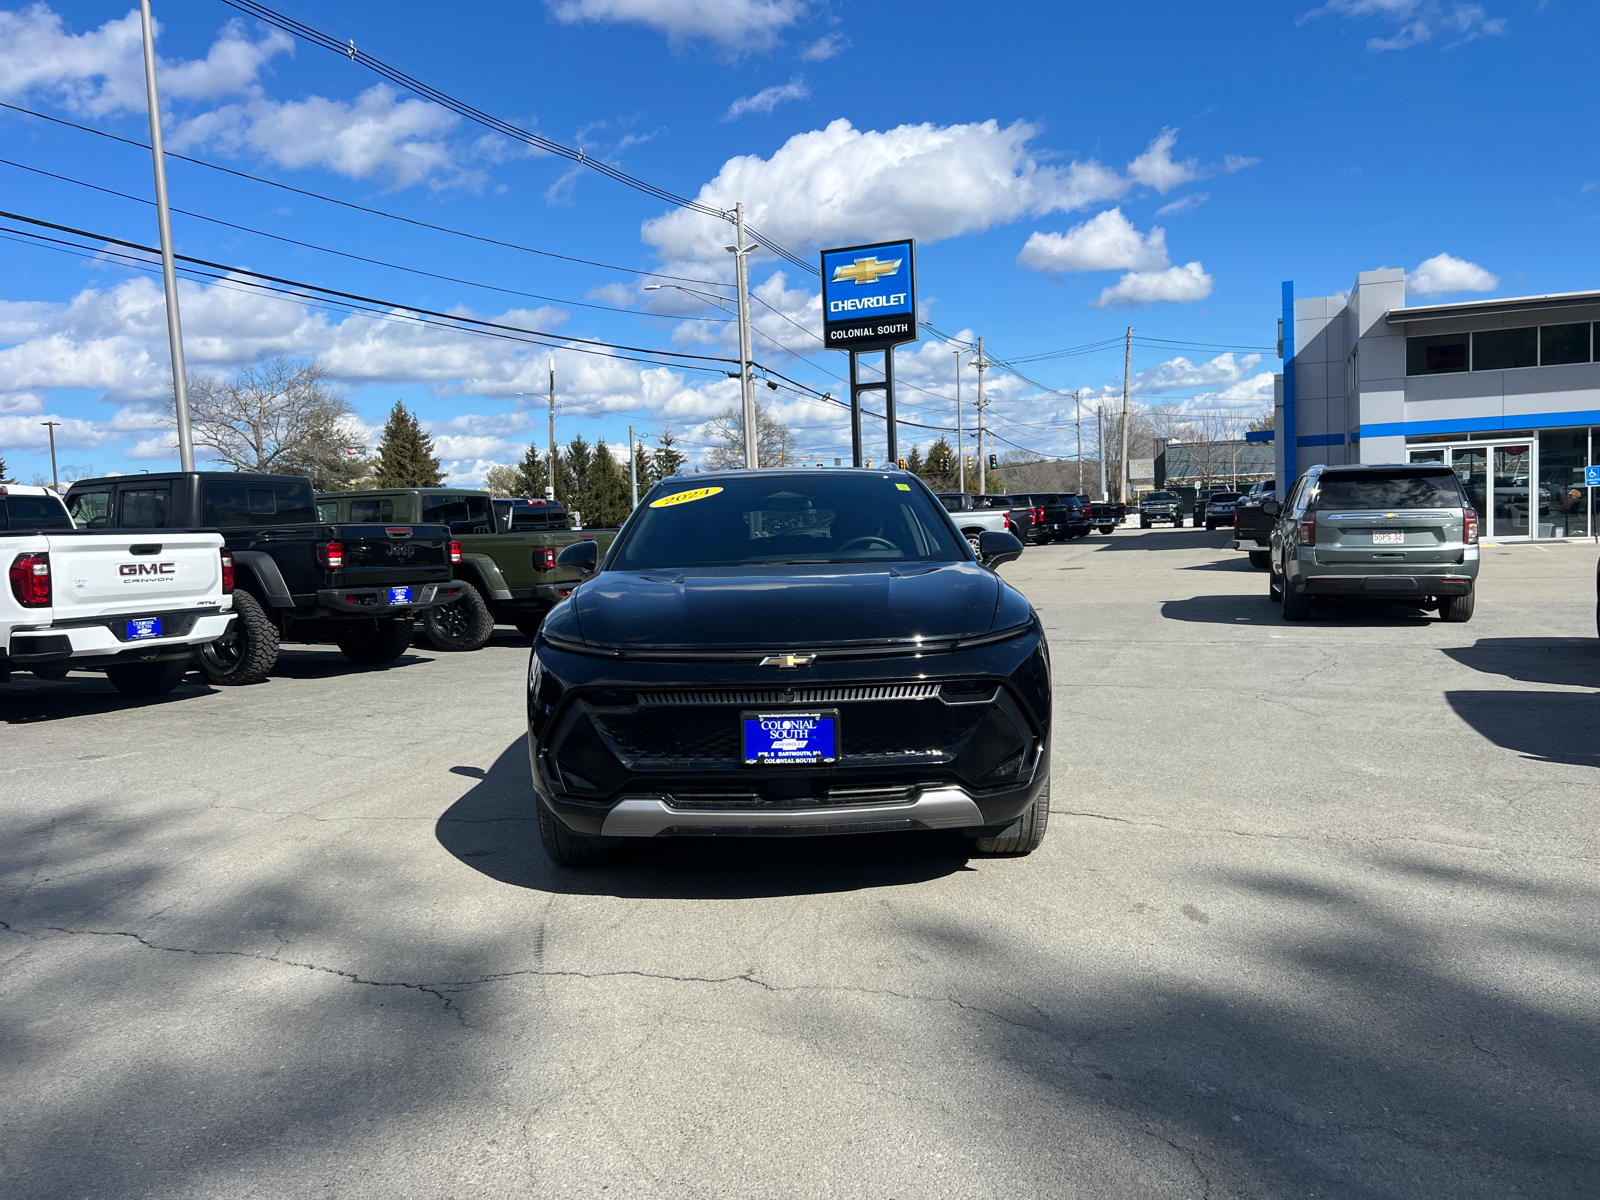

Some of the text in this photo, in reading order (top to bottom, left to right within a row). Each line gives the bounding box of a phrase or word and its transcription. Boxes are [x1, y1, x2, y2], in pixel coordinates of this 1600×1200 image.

[830, 293, 907, 312] CHEVROLET
[830, 323, 908, 340] COLONIAL SOUTH
[664, 489, 710, 505] 2024
[1393, 532, 1403, 541] 32
[385, 543, 415, 558] Jeep
[119, 562, 176, 576] GMC
[761, 720, 818, 731] COLONIAL
[769, 730, 809, 739] SOUTH
